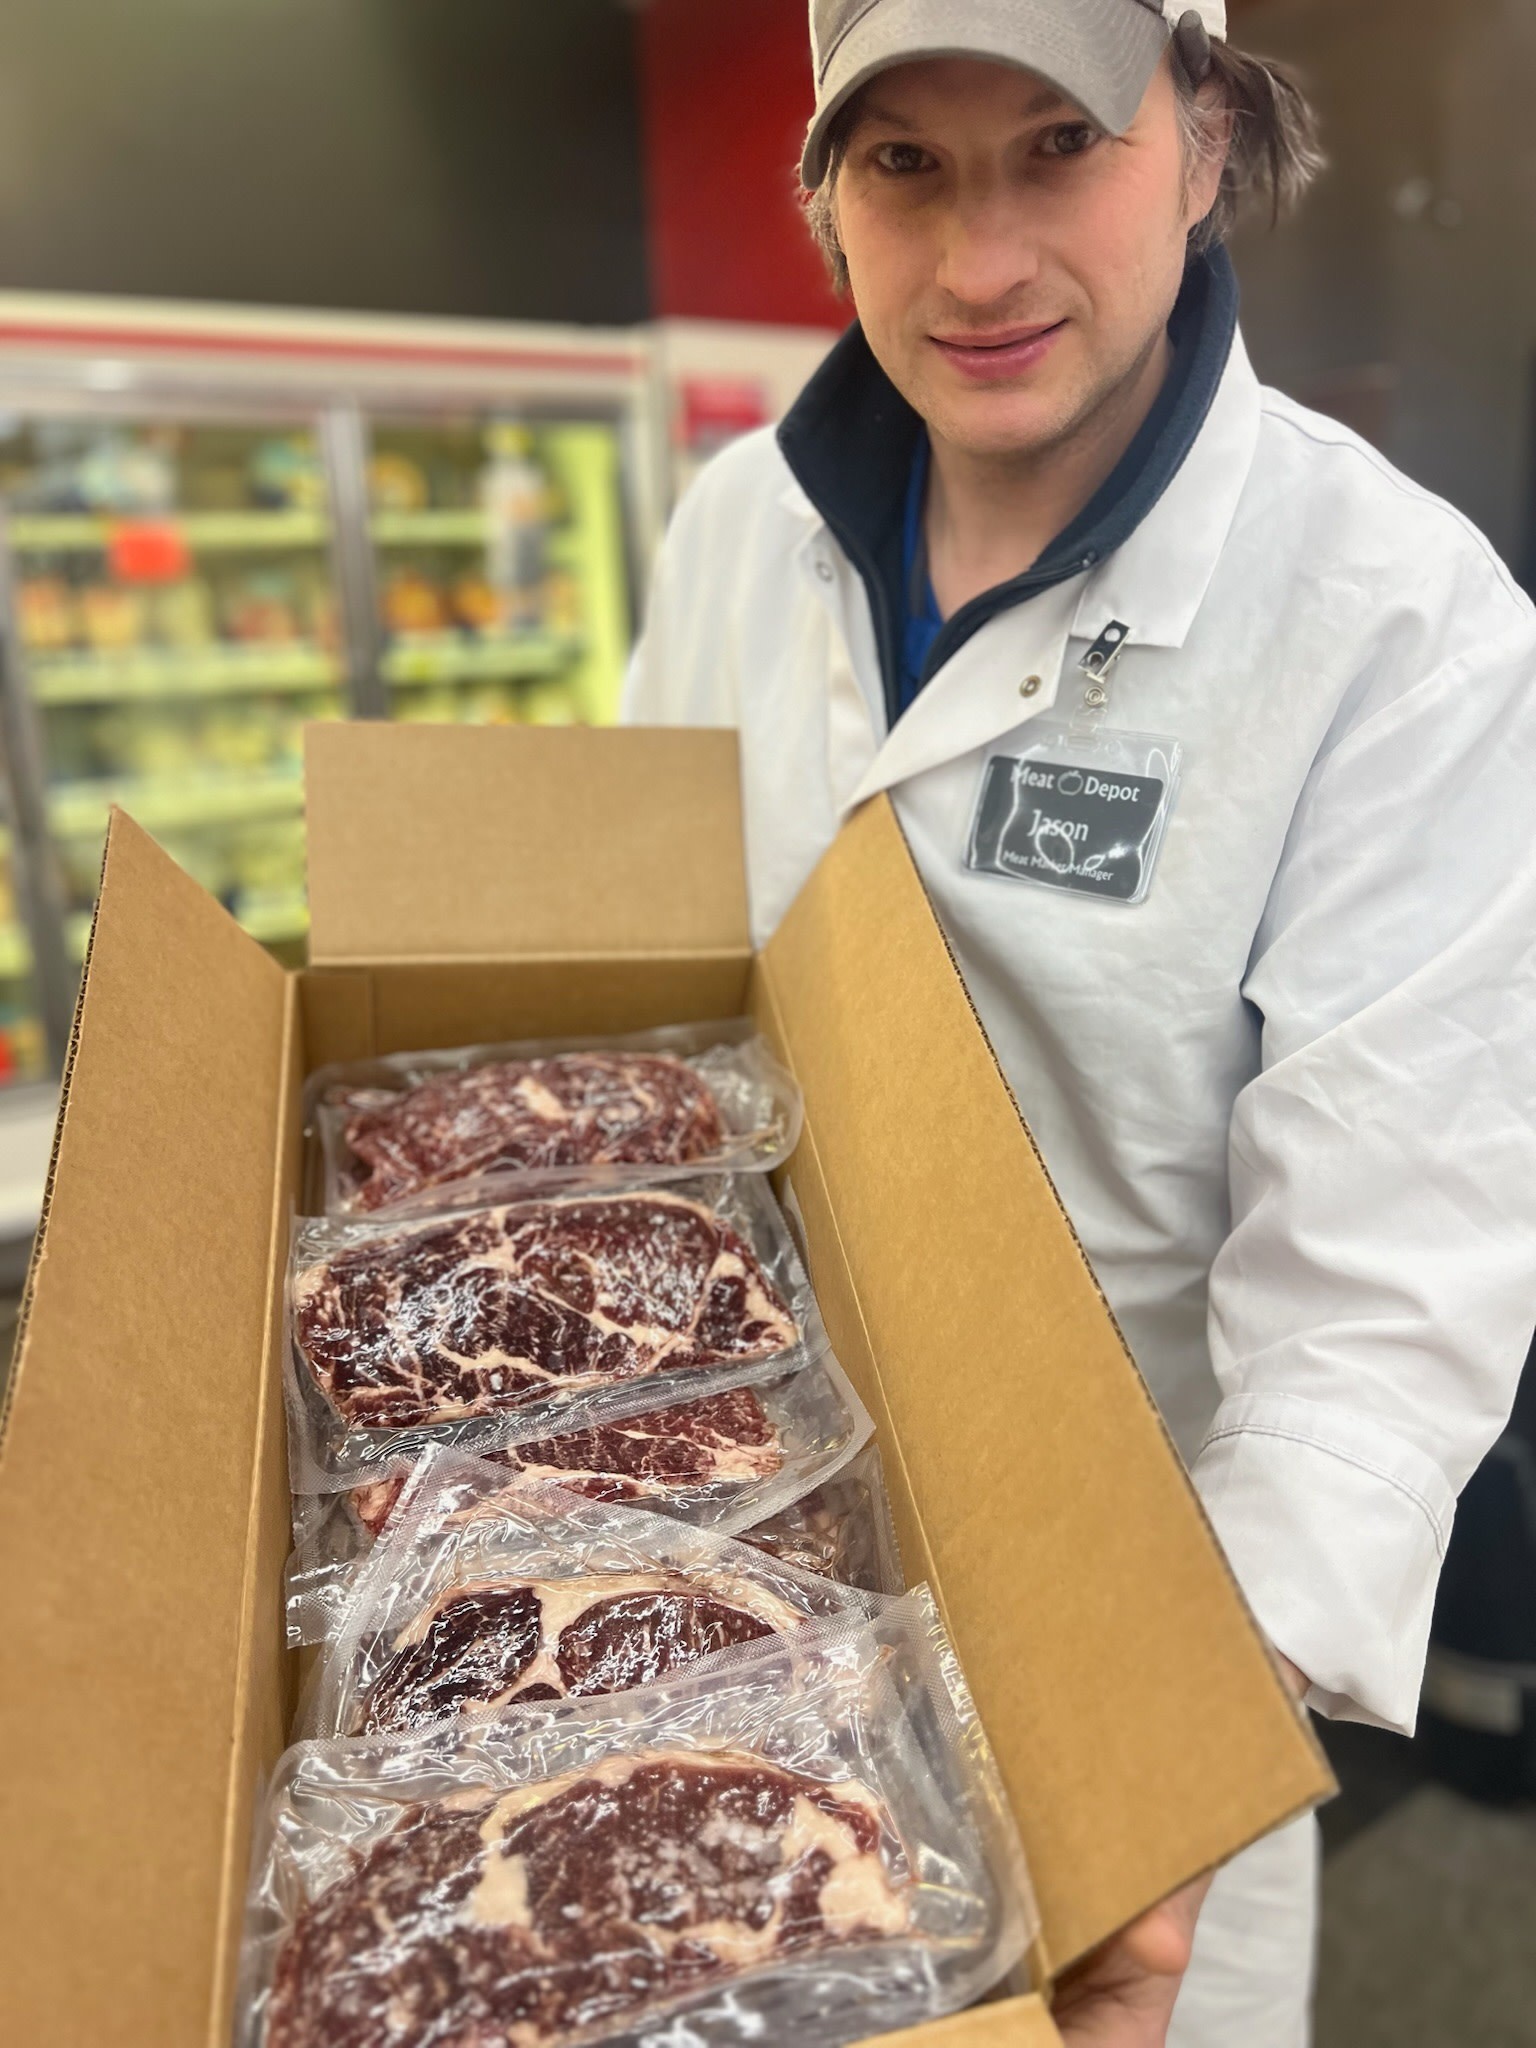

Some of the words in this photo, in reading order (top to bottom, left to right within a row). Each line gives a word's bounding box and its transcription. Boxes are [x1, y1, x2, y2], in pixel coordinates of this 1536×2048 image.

[1010, 764, 1055, 790] Meat
[1084, 776, 1140, 802] Depot
[1026, 808, 1089, 842] Jason
